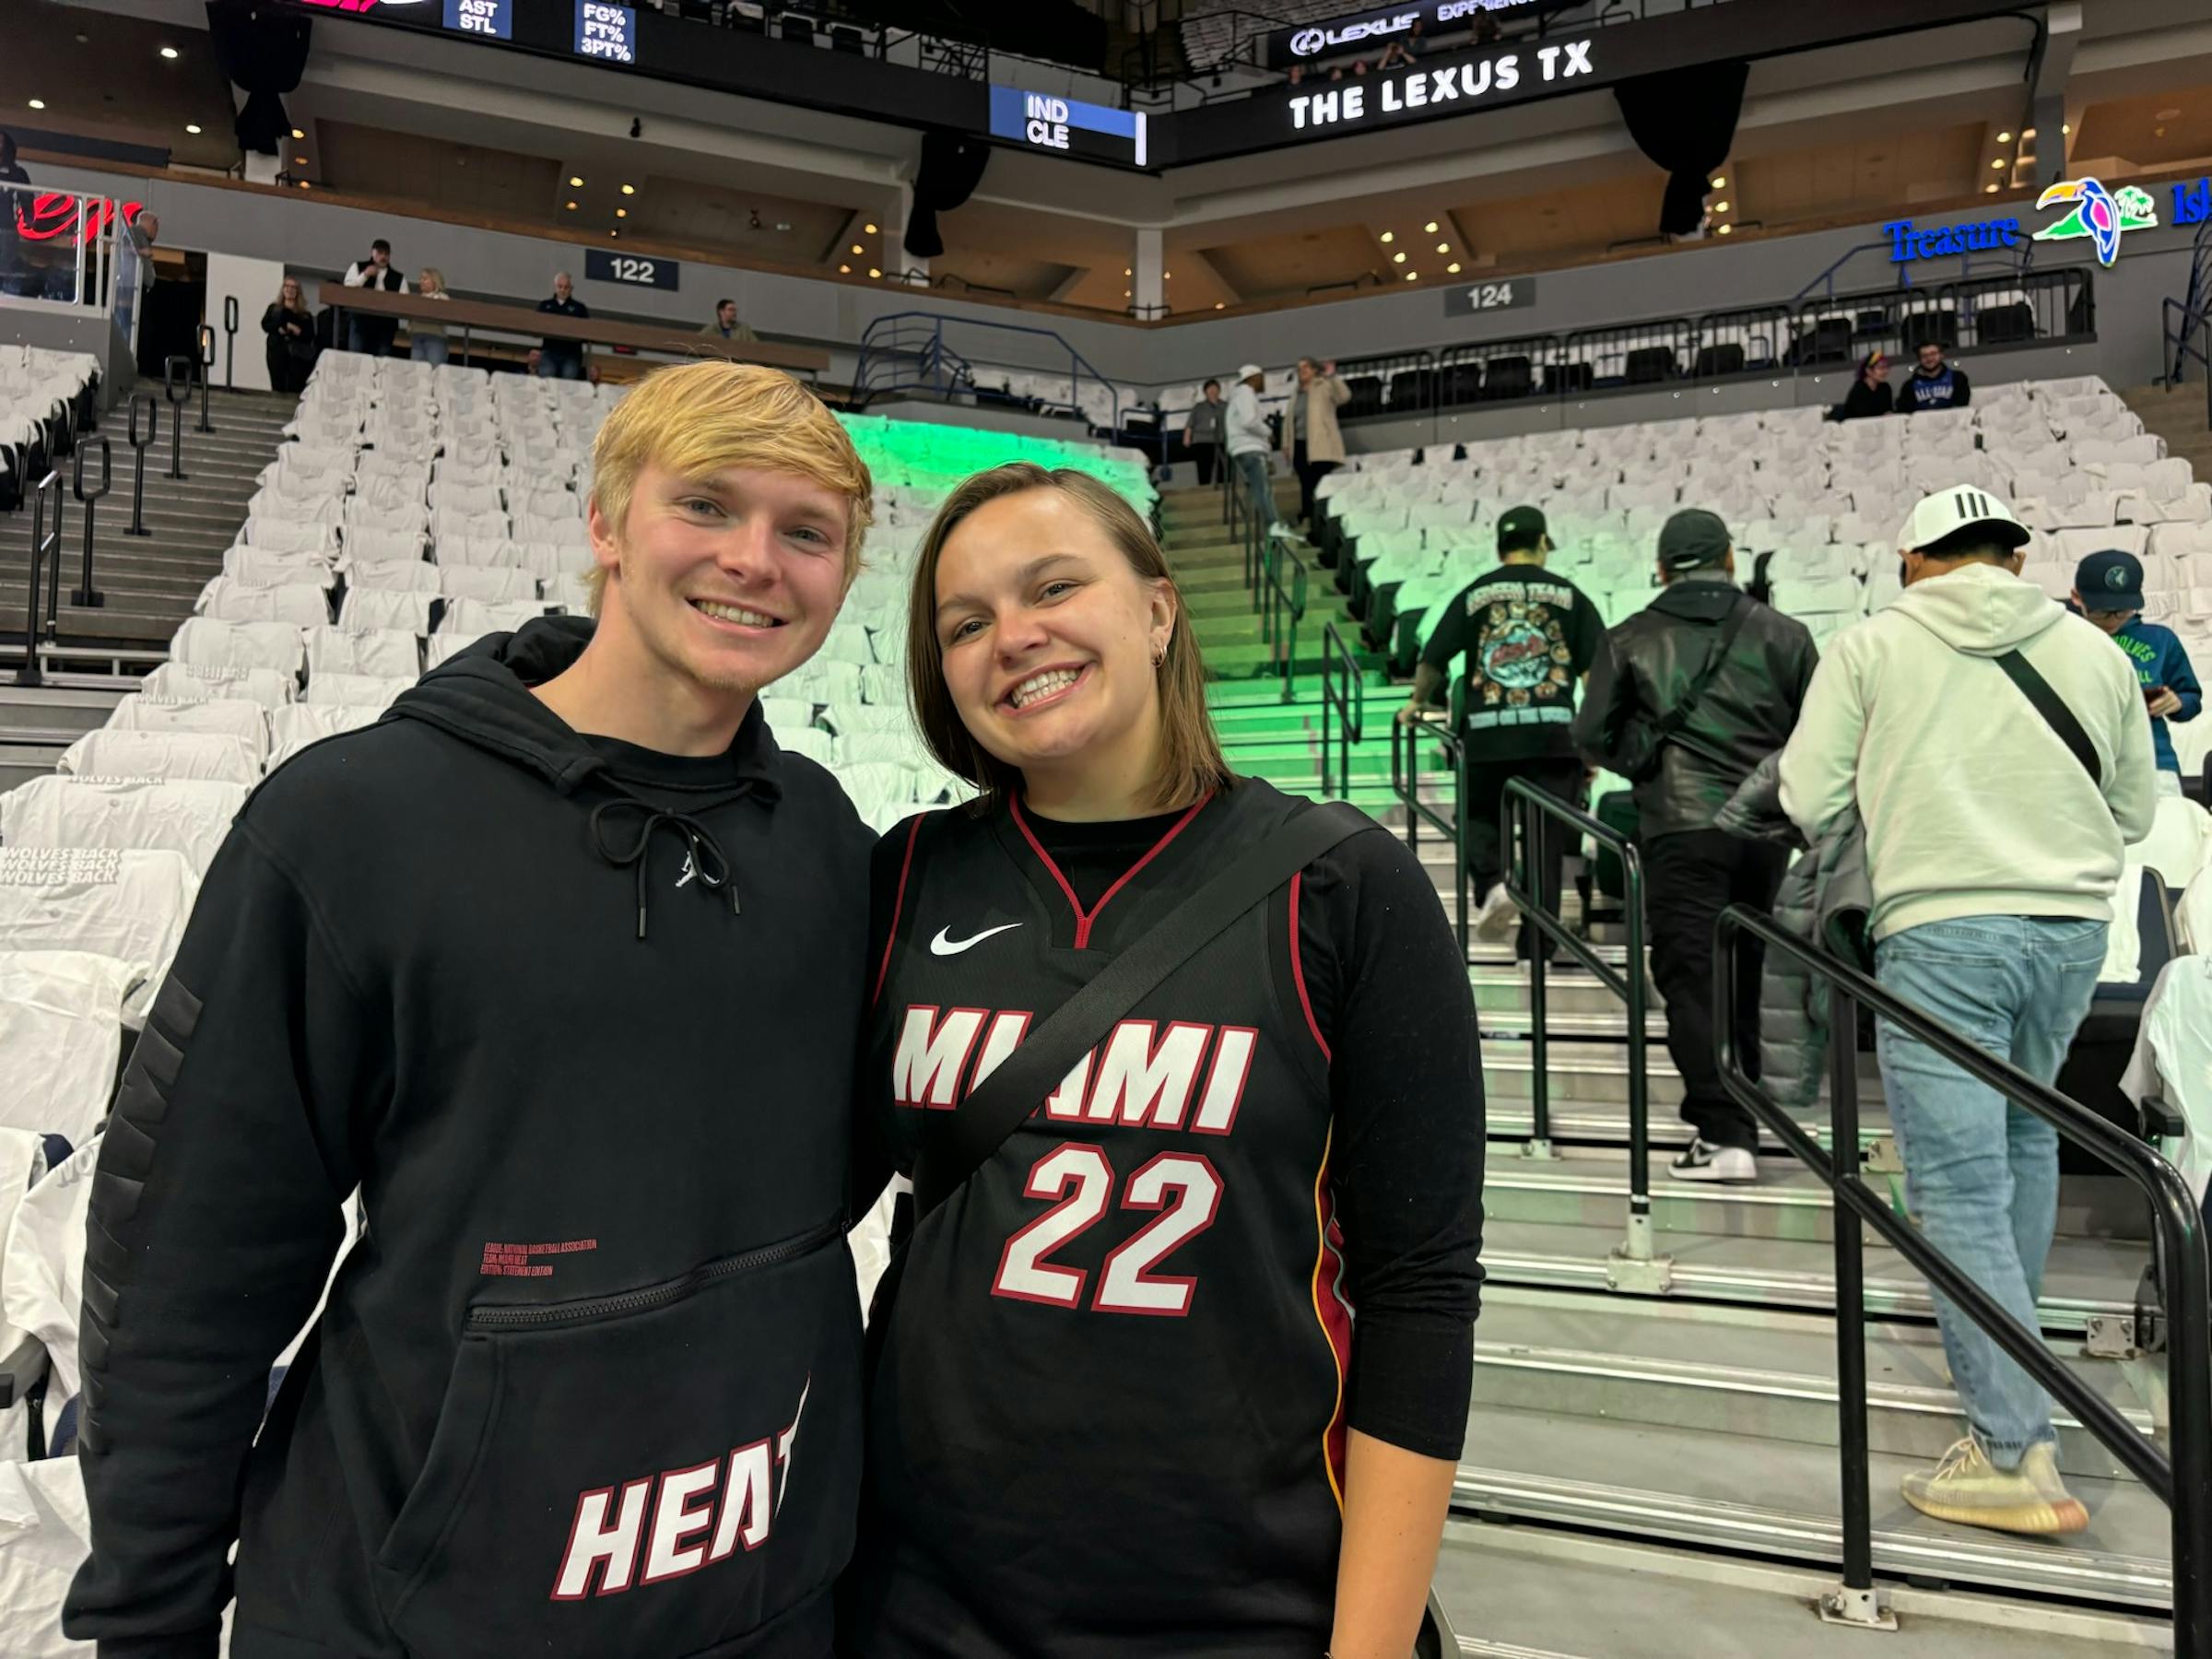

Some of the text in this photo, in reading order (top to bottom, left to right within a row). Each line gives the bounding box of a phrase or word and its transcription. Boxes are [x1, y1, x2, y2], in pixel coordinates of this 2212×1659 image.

[458, 0, 499, 18] AST
[582, 3, 627, 27] FG%
[459, 14, 498, 35] STL
[583, 20, 625, 43] FT%
[1325, 11, 1420, 45] LEXUS
[581, 38, 632, 63] 3PT%
[1288, 40, 1594, 129] THE LEXUS TX
[1027, 94, 1069, 124] IND
[1026, 119, 1070, 149] CLE
[1883, 217, 2021, 263] Treasure
[609, 257, 655, 284] 122
[1467, 282, 1513, 310] 124
[2114, 634, 2156, 663] OLVES
[0, 870, 118, 885] WOLVES BACK
[2, 858, 120, 872] WOLVES BACK
[990, 1141, 1226, 1317] 22
